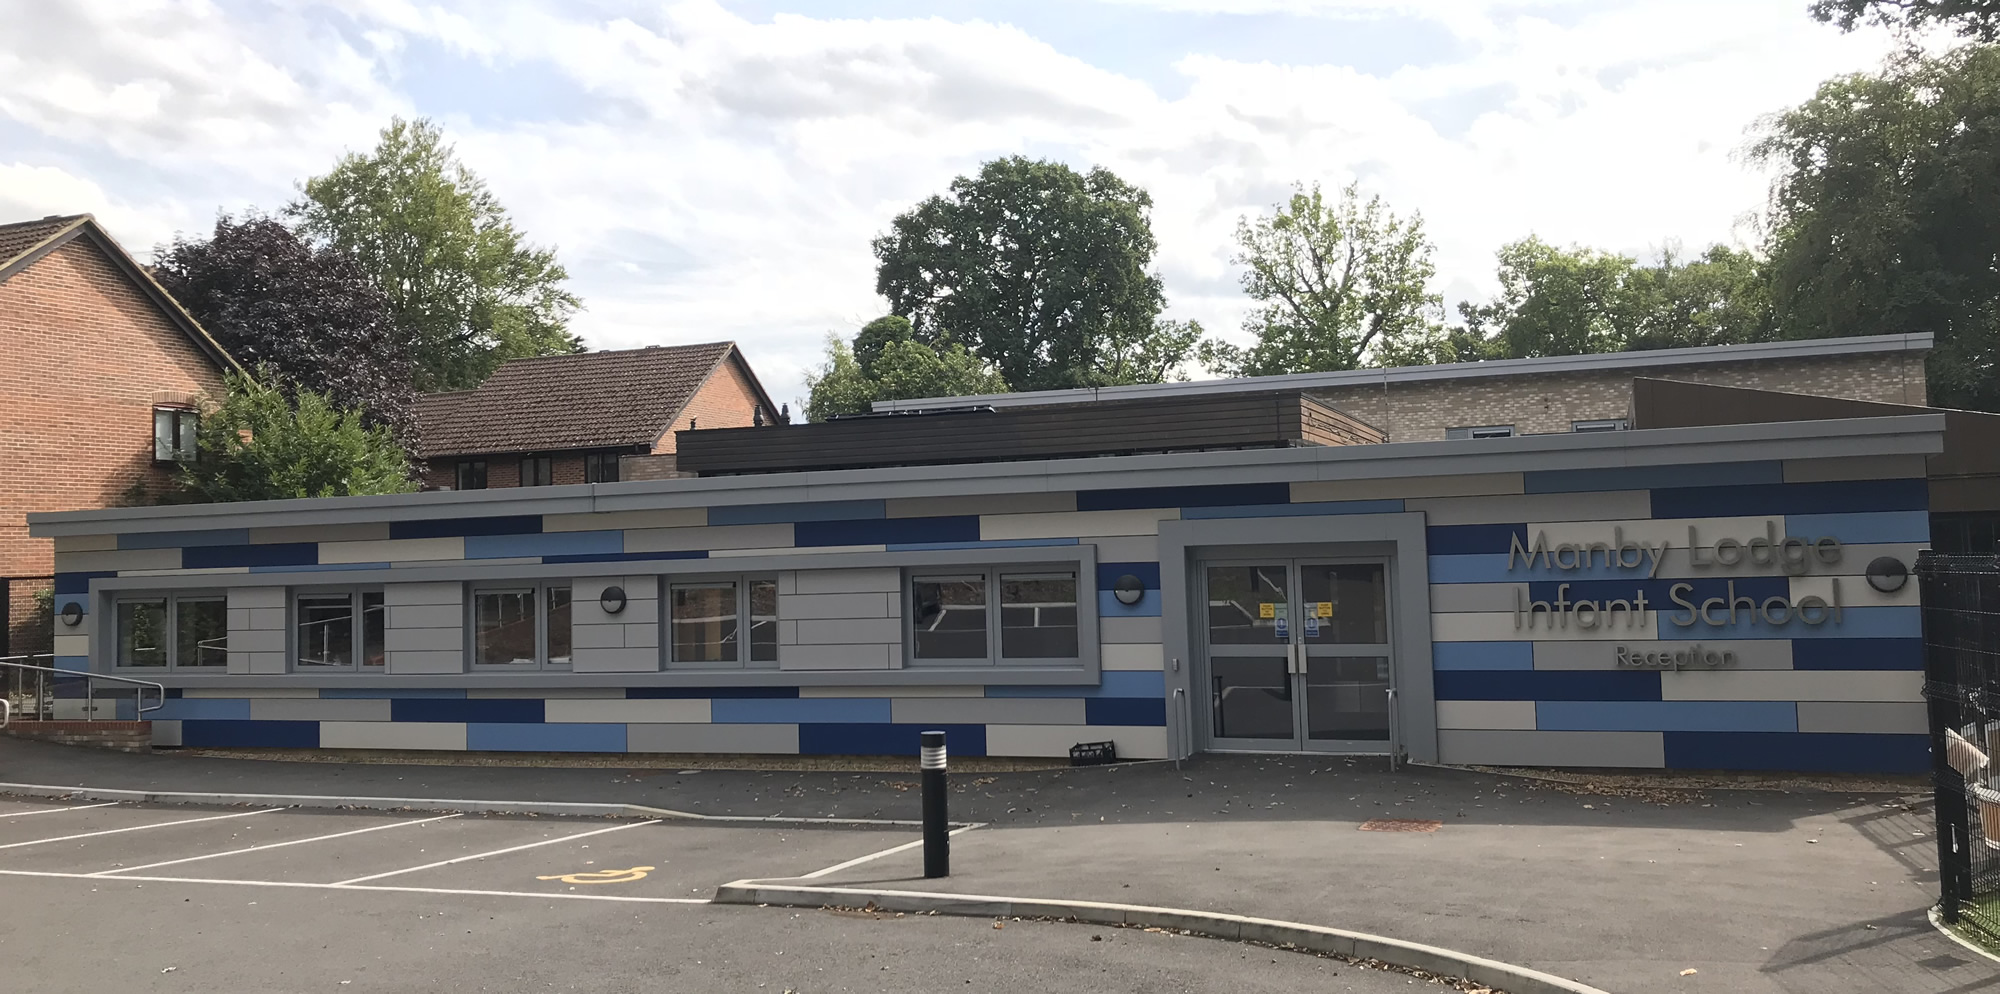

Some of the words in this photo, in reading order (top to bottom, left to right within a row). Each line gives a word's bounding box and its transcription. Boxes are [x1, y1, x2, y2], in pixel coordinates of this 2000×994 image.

[1508, 526, 1668, 579] Manby
[1688, 520, 1842, 575] Lodge
[1512, 583, 1649, 629] Infant
[1669, 578, 1842, 627] School
[1615, 644, 1737, 672] Reception
